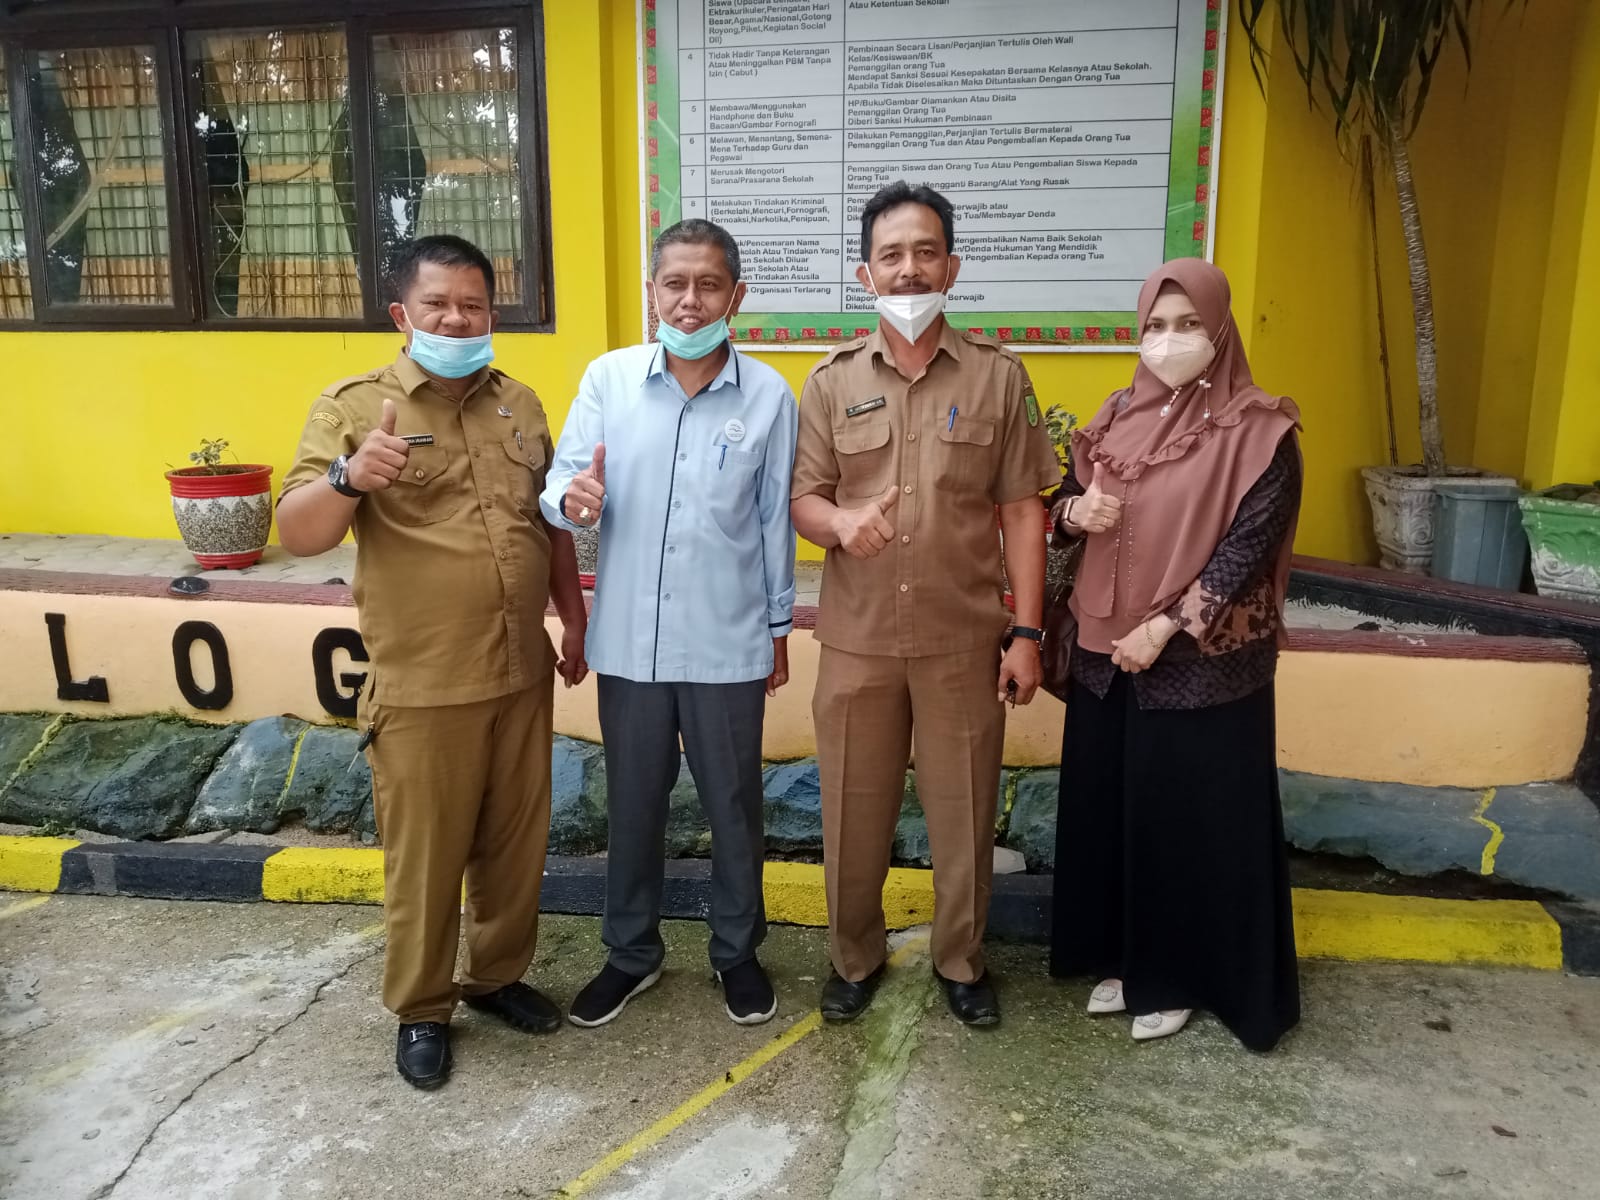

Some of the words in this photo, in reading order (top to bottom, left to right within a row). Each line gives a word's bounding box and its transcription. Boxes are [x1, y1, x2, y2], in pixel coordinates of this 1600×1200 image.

[849, 45, 894, 53] Pembinaan
[928, 41, 996, 50] Lisan/Perjanjian
[998, 38, 1030, 47] Tertulis
[756, 50, 780, 58] Tanpa
[783, 48, 830, 56] Keterangan
[849, 52, 932, 62] Kelas/Kesiswaan/BK
[729, 59, 783, 68] Meninggalkan
[848, 63, 901, 72] Pemanggilan
[848, 73, 888, 82] Mendapat
[951, 68, 1005, 78] Kesepakatan
[1049, 65, 1088, 74] Kelasnya
[1114, 62, 1152, 70] Sekolah.
[848, 82, 878, 91] Apabila
[906, 79, 958, 88] Diselesaikan
[986, 76, 1036, 85] Dituntaskan
[1039, 75, 1072, 84] Dengan
[1074, 74, 1102, 82] Orang
[848, 98, 919, 107] HP/Buku/Gambar
[922, 97, 968, 105] Diamankan
[710, 102, 806, 112] Membawa/Menggunakan
[848, 108, 900, 116] Pemanggilan
[710, 113, 755, 122] Handphone
[946, 114, 992, 122] Pembinaan
[710, 121, 773, 130] Bacaan/Gambar
[776, 119, 816, 128] Fornografi
[890, 129, 987, 139] Pemanggilan,Perjanjian
[1025, 126, 1072, 134] Bermaterai
[710, 136, 746, 144] Melawan,
[749, 134, 794, 143] Menantang,
[848, 140, 900, 149] Pemanggilan
[903, 140, 928, 148] Orang
[987, 135, 1047, 145] Pengembalian
[1049, 134, 1082, 144] Kepada
[1085, 134, 1113, 143] Orang
[733, 144, 770, 153] Terhadap
[711, 154, 742, 163] Pegawai
[848, 165, 899, 173] Pemanggilan
[1014, 159, 1074, 169] Pengembalian
[1104, 158, 1137, 167] Kepada
[746, 167, 784, 176] Mengotori
[711, 176, 780, 184] Sarana/Prasarana
[968, 179, 1018, 188] Barang/Alat
[711, 206, 830, 216] (Berkelahi,Mencuri,Fornografi,
[964, 211, 1025, 220] Tua/Membayar
[711, 215, 830, 224] Fornoaksi,Narkotika,Penipuan,
[1035, 244, 1056, 252] Yang
[966, 254, 1024, 262] Pengembalian
[1027, 253, 1059, 261] Kepada
[948, 294, 984, 302] Berwajib
